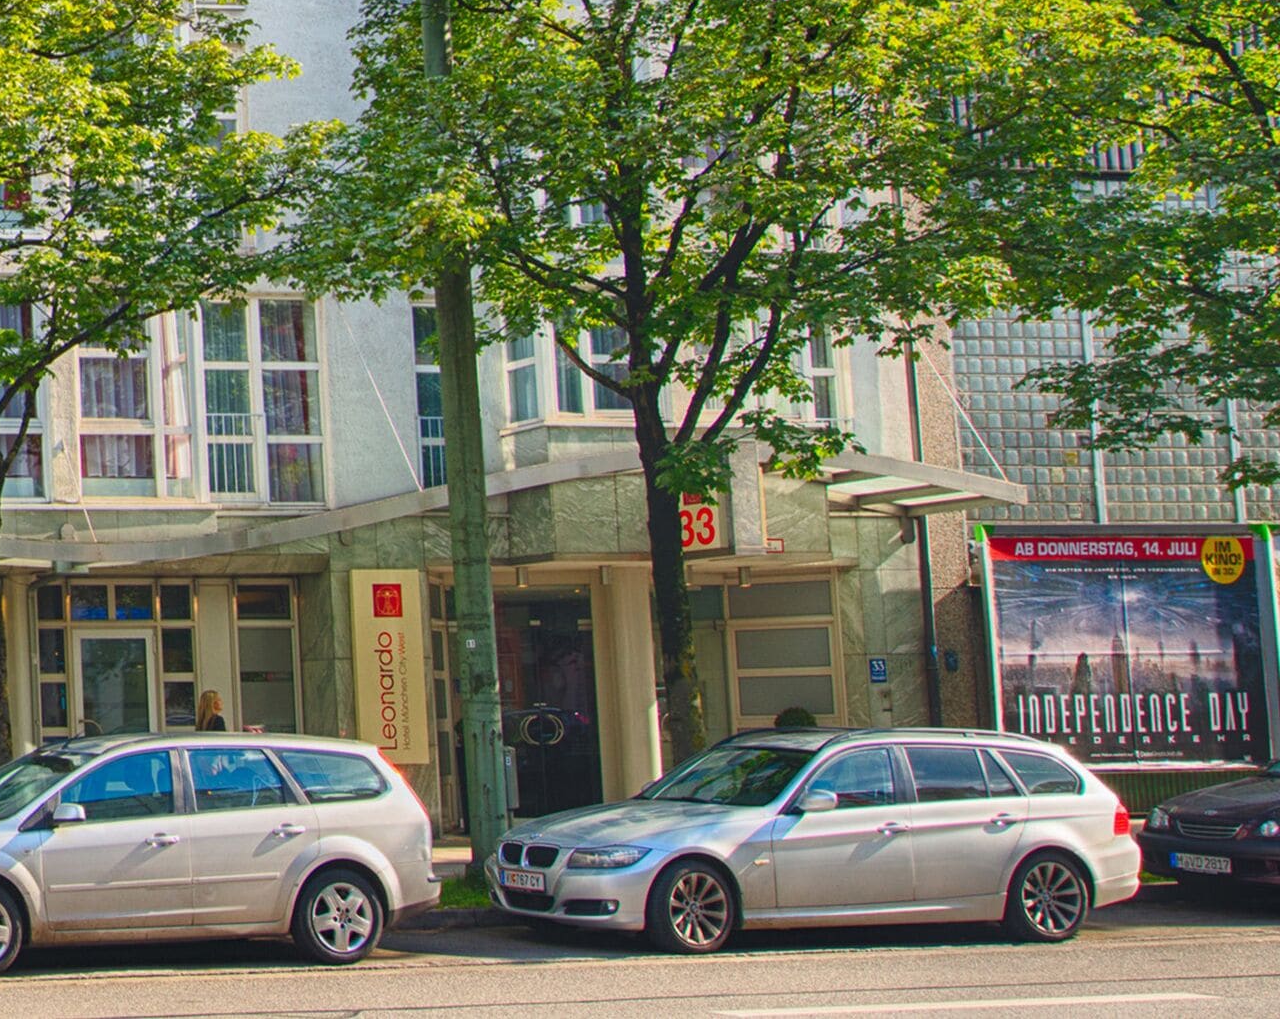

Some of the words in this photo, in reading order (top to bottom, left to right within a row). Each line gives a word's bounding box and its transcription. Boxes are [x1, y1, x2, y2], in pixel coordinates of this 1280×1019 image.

[679, 506, 715, 547] 33
[1014, 542, 1034, 556] AB
[1038, 542, 1138, 558] DONNERSTAG,
[1142, 542, 1163, 556] 14.
[1167, 541, 1197, 556] JULI
[1214, 541, 1231, 553] IM
[1204, 552, 1242, 566] KINO!
[374, 631, 398, 750] Leonardo
[1018, 693, 1192, 734] INDEPENDENCE
[1208, 692, 1249, 731] DAY
[1047, 734, 1251, 745] IEDERKEHR
